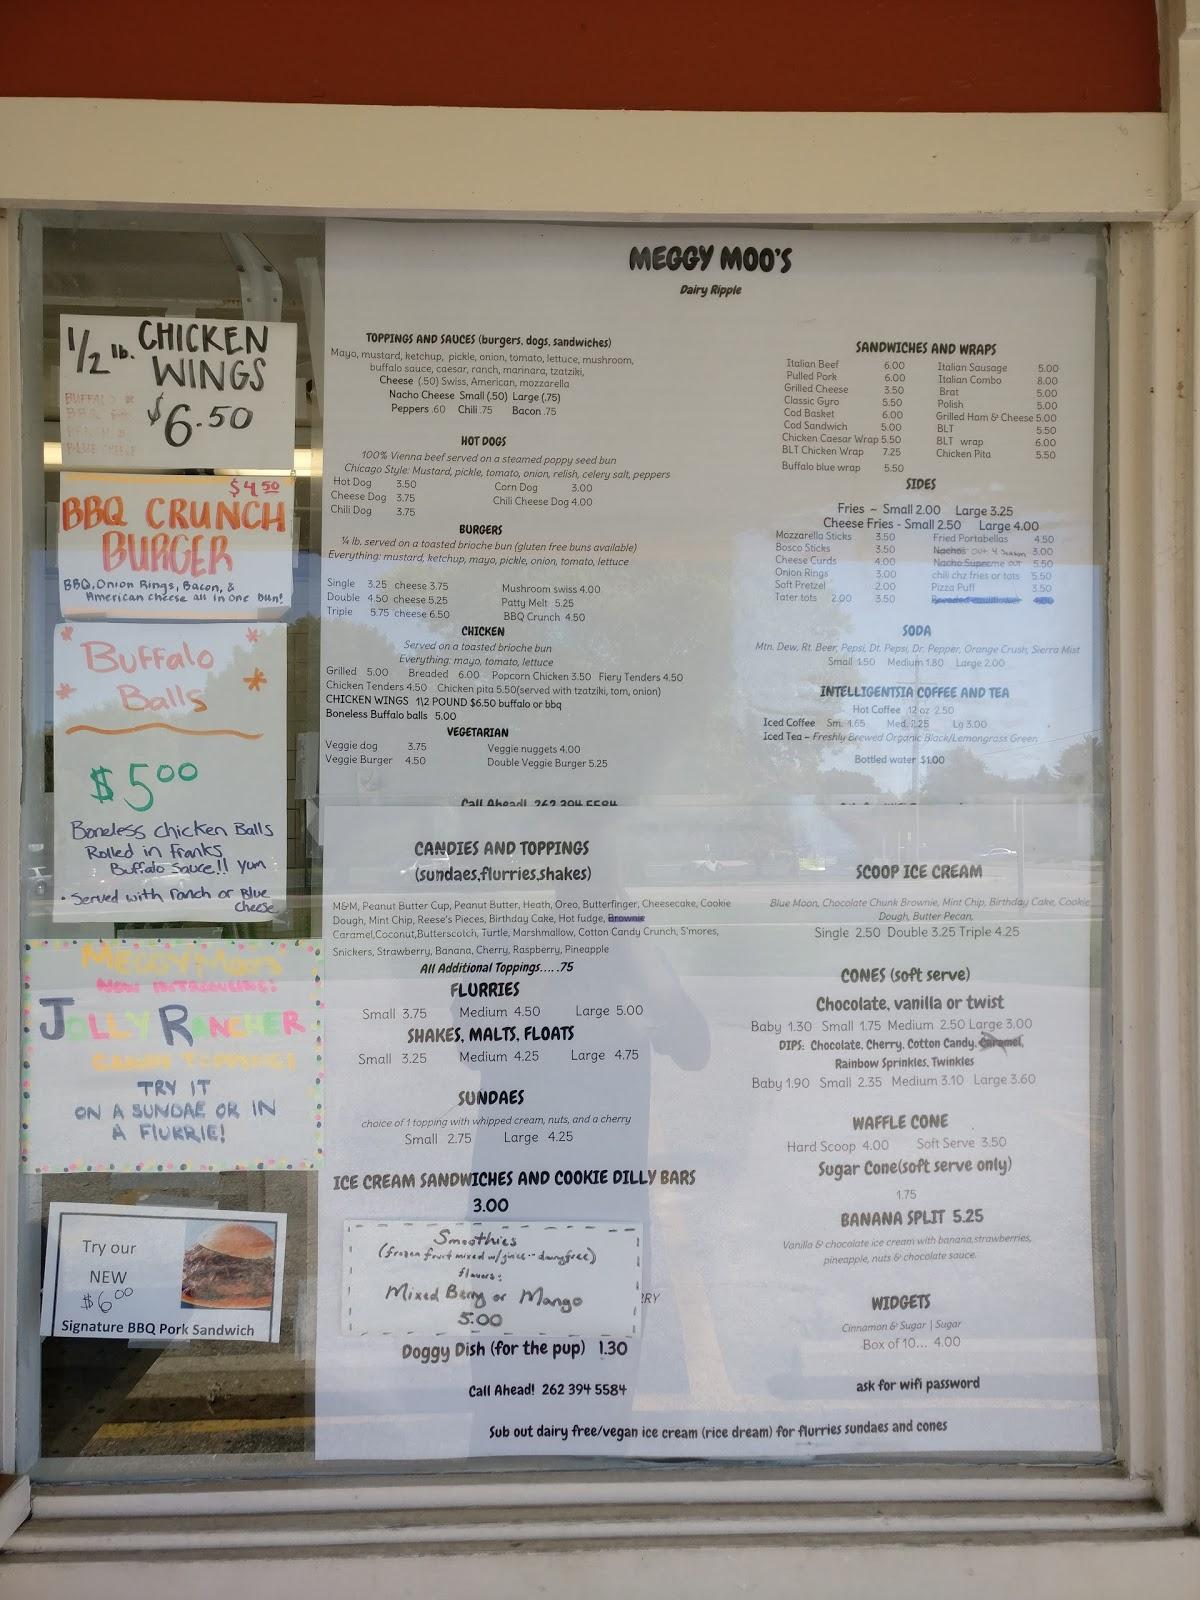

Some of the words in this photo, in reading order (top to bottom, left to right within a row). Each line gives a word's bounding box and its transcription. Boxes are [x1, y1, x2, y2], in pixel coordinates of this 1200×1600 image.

[629, 245, 714, 271] MEGGY
[720, 246, 792, 273] MOO'S
[680, 285, 711, 297] Dairy
[710, 285, 742, 298] Ripple
[138, 320, 268, 355] CHICKEN
[366, 333, 413, 344] TOPPINGS
[416, 334, 437, 344] AND
[441, 334, 475, 344] SAUCES
[479, 335, 523, 348] (burgers,
[526, 335, 550, 349] dogs,
[553, 337, 611, 348] sandwiches)
[856, 341, 927, 354] SANDWICHES
[931, 343, 956, 354] AND
[960, 344, 997, 355] WRAPS
[152, 356, 266, 391] WINGS
[390, 389, 419, 399] Nacho
[421, 390, 454, 399] Cheese
[460, 391, 484, 400] Small
[487, 391, 507, 402] (.50)
[513, 392, 539, 403] Large
[542, 393, 560, 404] (.75)
[784, 383, 813, 392] Grilled
[816, 384, 848, 393] Cheese
[884, 386, 904, 395] 3.50
[461, 435, 483, 447] HOT
[485, 436, 507, 446] DOGS
[495, 482, 516, 492] Corn
[520, 483, 538, 493] Dog
[572, 483, 592, 493] 3.00
[906, 478, 936, 490] SIDES
[63, 496, 128, 531] BBQ
[146, 498, 286, 532] CRUNCH
[838, 503, 864, 513] Fries
[883, 504, 913, 514] Small
[916, 505, 941, 515] 2.00
[956, 505, 987, 518] Large
[990, 506, 1013, 516] 3.25
[460, 525, 502, 535] BURGERS
[102, 530, 232, 578] BURGER
[327, 577, 355, 589] Single
[368, 580, 387, 589] 3.25
[394, 581, 427, 590] cheese
[429, 581, 449, 591] 3.75
[503, 584, 551, 593] Mushroom
[552, 585, 577, 593] swiss
[580, 585, 600, 594] 4.00
[462, 626, 504, 636] CHICKEN
[903, 625, 931, 636] SODA
[80, 640, 214, 674] Buffalo
[117, 685, 208, 714] Balls
[820, 685, 913, 698] INTELLIGENTSIA
[916, 687, 957, 698] COFFEE
[960, 687, 985, 699] AND
[989, 687, 1009, 699] TEA
[326, 694, 371, 704] CHICKEN
[374, 696, 408, 705] WINGS
[432, 697, 467, 706] POUND
[470, 698, 496, 707] $6.50
[499, 699, 530, 708] buffalo
[545, 700, 561, 711] bbq
[447, 727, 508, 737] VEGETARIAN
[414, 841, 480, 857] CANDIES
[483, 841, 516, 856] AND
[520, 841, 589, 855] TOPPINGS
[856, 864, 899, 879] SCOOP
[903, 864, 928, 879] ICE
[932, 864, 982, 879] CREAM
[841, 968, 886, 983] CONES
[890, 967, 923, 983] (soft
[927, 967, 970, 982] serve)
[451, 982, 520, 997] FLURRIES
[816, 996, 890, 1012] Chocolate,
[894, 996, 942, 1010] vanilla
[947, 998, 963, 1010] or
[966, 995, 1004, 1009] twist
[363, 1008, 395, 1021] Small
[401, 1008, 427, 1019] 3.75
[460, 1006, 507, 1017] Medium
[514, 1006, 540, 1016] 4.50
[576, 1005, 609, 1018] Large
[617, 1005, 643, 1015] 5.00
[39, 997, 147, 1040] JOLLY
[159, 1004, 305, 1047] RANCHER
[408, 1027, 464, 1043] SHAKES,
[469, 1026, 519, 1042] MALTS,
[525, 1026, 574, 1040] FLOATS
[137, 1080, 176, 1096] TRY
[191, 1079, 211, 1096] IT
[458, 1090, 524, 1106] SUNDAES
[75, 1104, 101, 1120] ON
[113, 1103, 124, 1120] A
[132, 1101, 205, 1120] SUNDAE
[216, 1102, 240, 1120] OR
[252, 1100, 276, 1117] IN
[853, 1115, 906, 1130] WAFFLE
[911, 1113, 948, 1129] CONE
[112, 1124, 126, 1140] A
[819, 1161, 860, 1181] Sugar
[934, 1160, 973, 1172] serve
[977, 1156, 1012, 1176] only)
[334, 1175, 361, 1190] ICE
[363, 1174, 415, 1190] CREAM
[421, 1171, 513, 1188] SANDWICHES
[518, 1171, 550, 1185] AND
[555, 1170, 608, 1185] COOKIE
[613, 1170, 656, 1185] DILLY
[661, 1170, 696, 1185] BARS
[474, 1198, 508, 1212] 3.00
[841, 1211, 902, 1227] BANANA
[907, 1209, 945, 1225] SPLIT
[953, 1208, 984, 1223] 5.25
[83, 1240, 106, 1256] Try
[111, 1244, 136, 1254] our
[90, 1270, 127, 1284] NEW
[872, 1294, 930, 1311] WIDGETS
[62, 1320, 123, 1334] Signature
[128, 1322, 155, 1335] BBQ
[160, 1324, 188, 1334] Pork
[192, 1324, 254, 1336] Sandwich
[402, 1344, 450, 1364] Doggy
[456, 1341, 485, 1356] Dish
[491, 1340, 519, 1356] (for
[522, 1340, 548, 1355] the
[553, 1340, 585, 1359] pup)
[600, 1341, 627, 1355] 1.30
[469, 1385, 490, 1397] Call
[495, 1383, 534, 1396] Ahead!
[542, 1384, 564, 1395] 262
[569, 1384, 591, 1395] 394
[595, 1384, 627, 1396] 5584
[857, 1380, 875, 1392] ask
[878, 1379, 896, 1391] for
[900, 1378, 922, 1390] wifi
[926, 1376, 980, 1393] password
[490, 1426, 510, 1438] Sub
[514, 1425, 533, 1437] out
[537, 1424, 568, 1441] dairy
[572, 1425, 638, 1441] free/vegan
[642, 1426, 658, 1438] ice
[662, 1429, 697, 1439] cream
[702, 1425, 728, 1440] (rice
[732, 1425, 772, 1438] dream)
[776, 1425, 795, 1438] for
[798, 1424, 841, 1437] flurries
[845, 1421, 888, 1434] sundaes
[892, 1419, 913, 1432] and
[917, 1421, 947, 1432] cones
